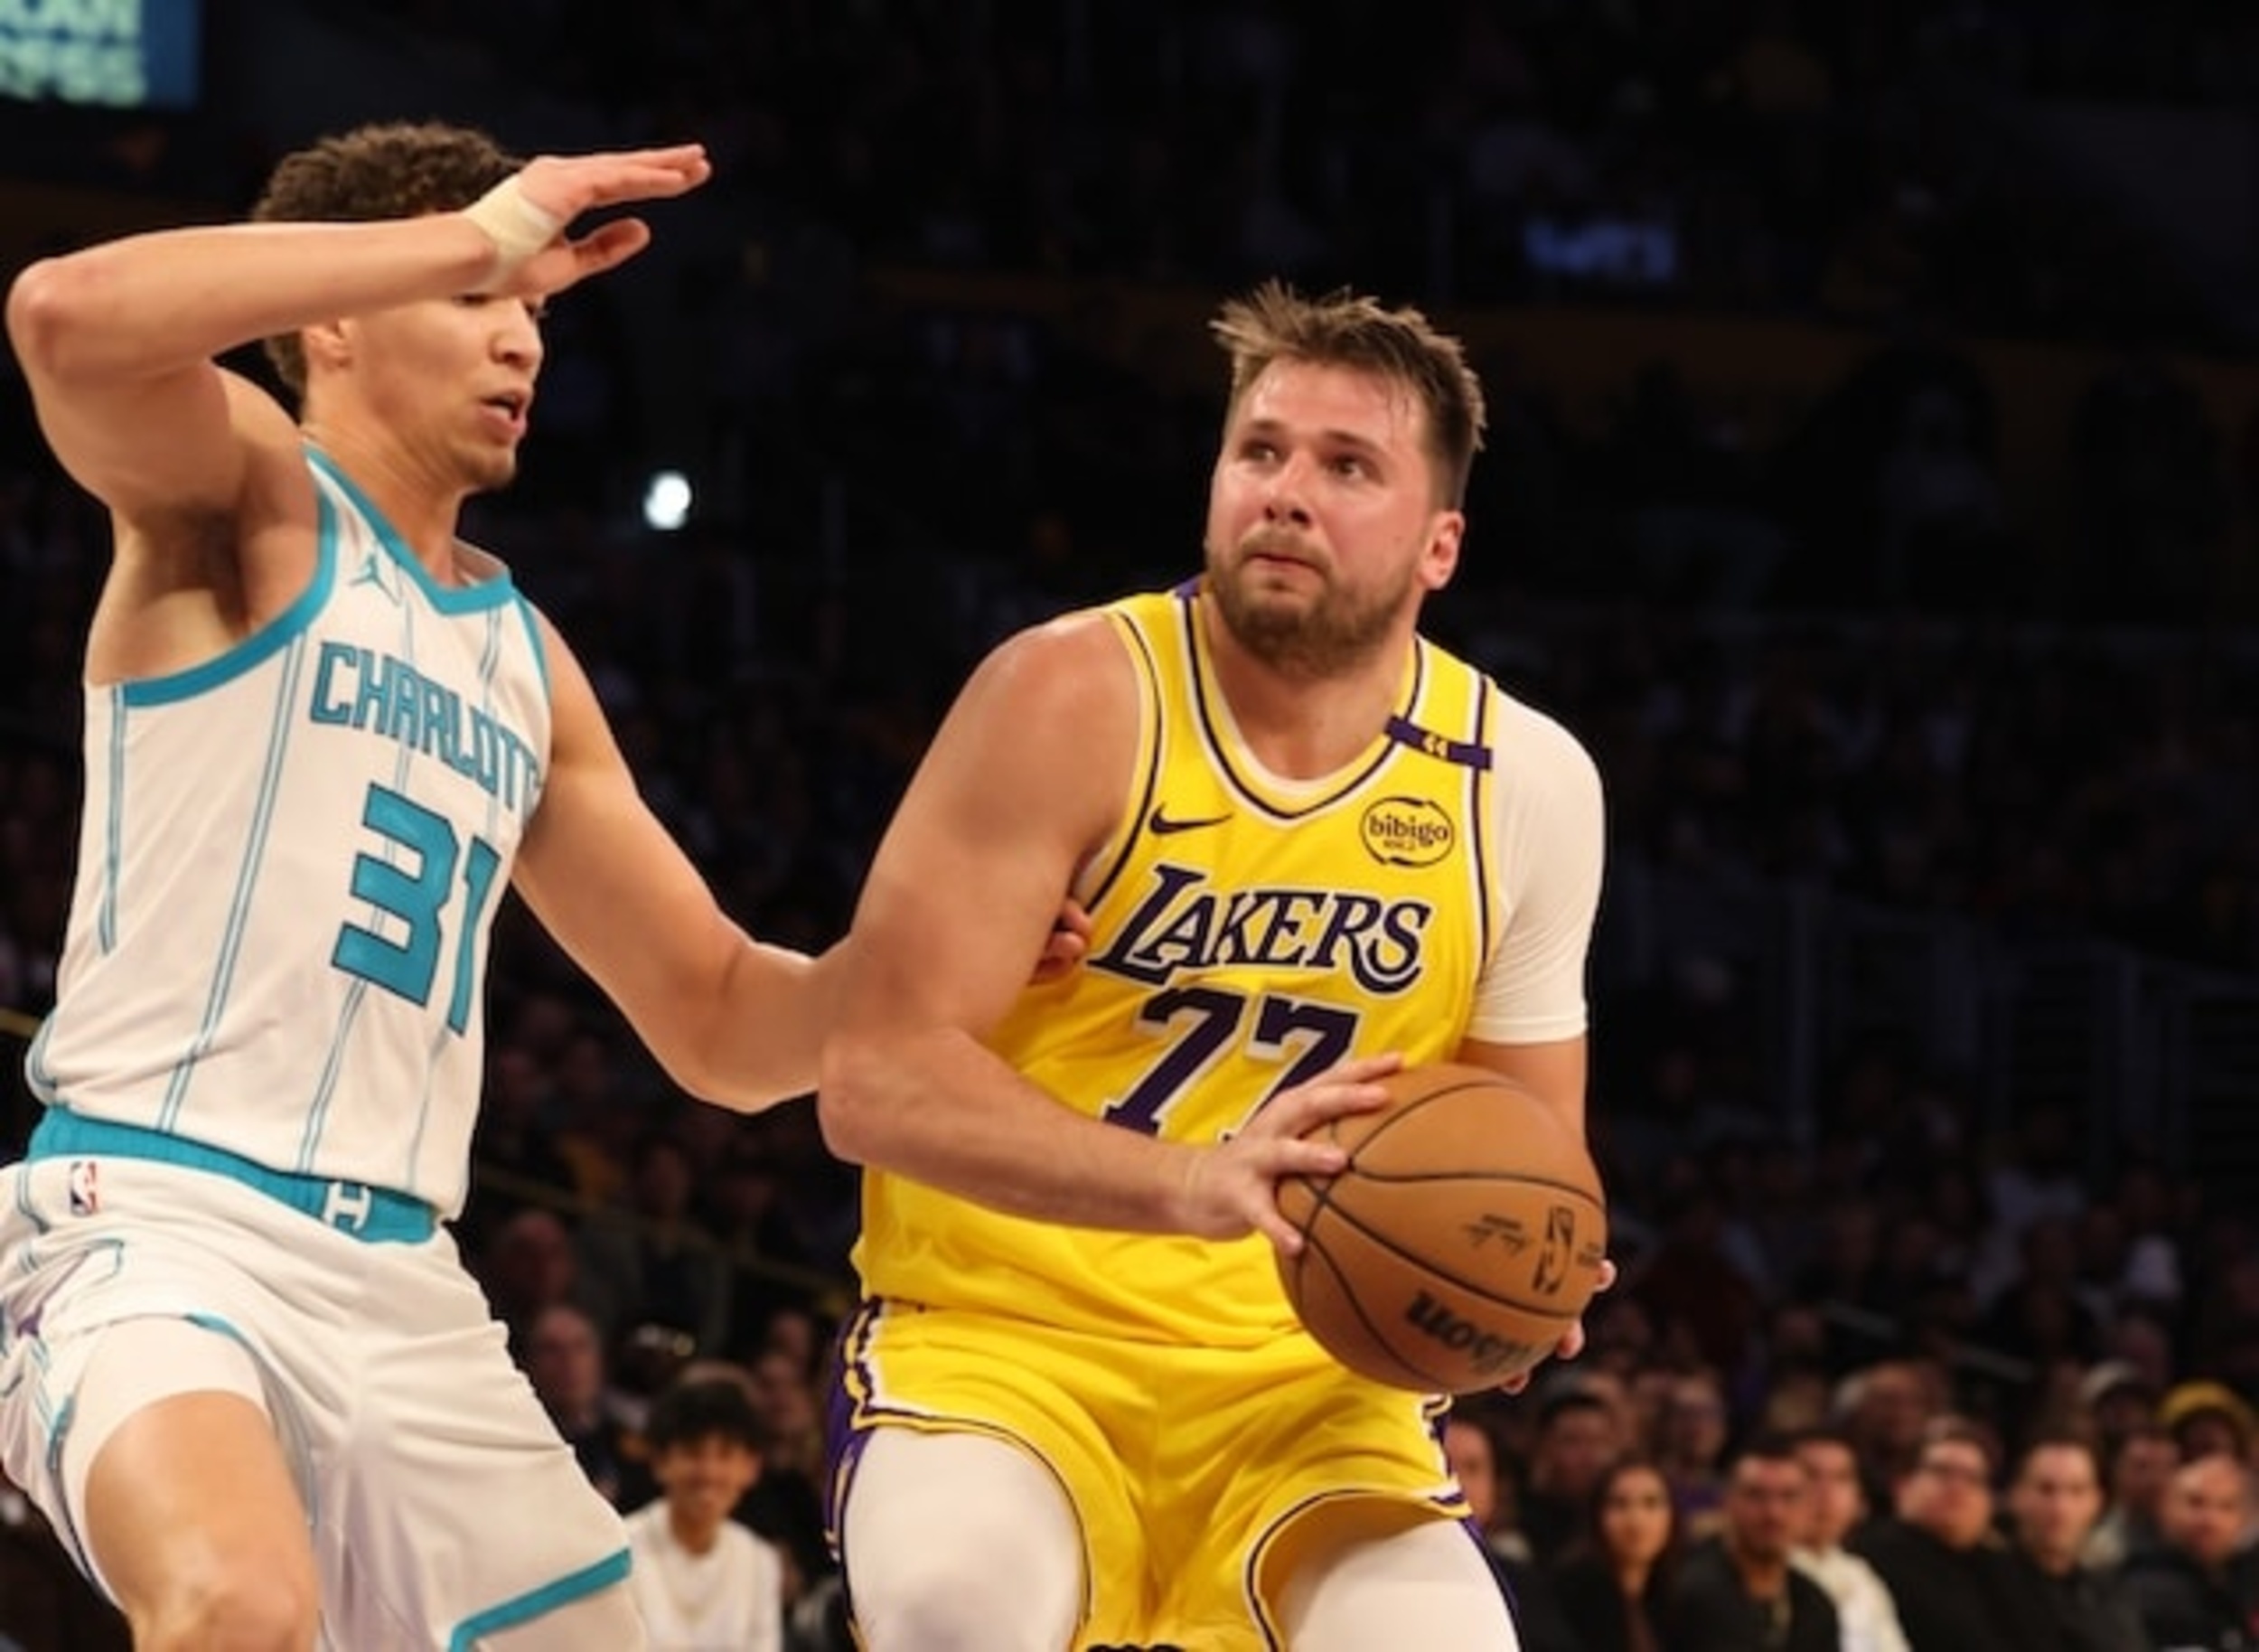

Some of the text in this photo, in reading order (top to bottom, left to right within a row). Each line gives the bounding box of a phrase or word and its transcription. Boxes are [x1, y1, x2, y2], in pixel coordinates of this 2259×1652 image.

[1369, 812, 1449, 847] bibigo
[331, 782, 502, 1037] 31
[1085, 863, 1433, 995] LAKERS
[1101, 987, 1361, 1141] 77
